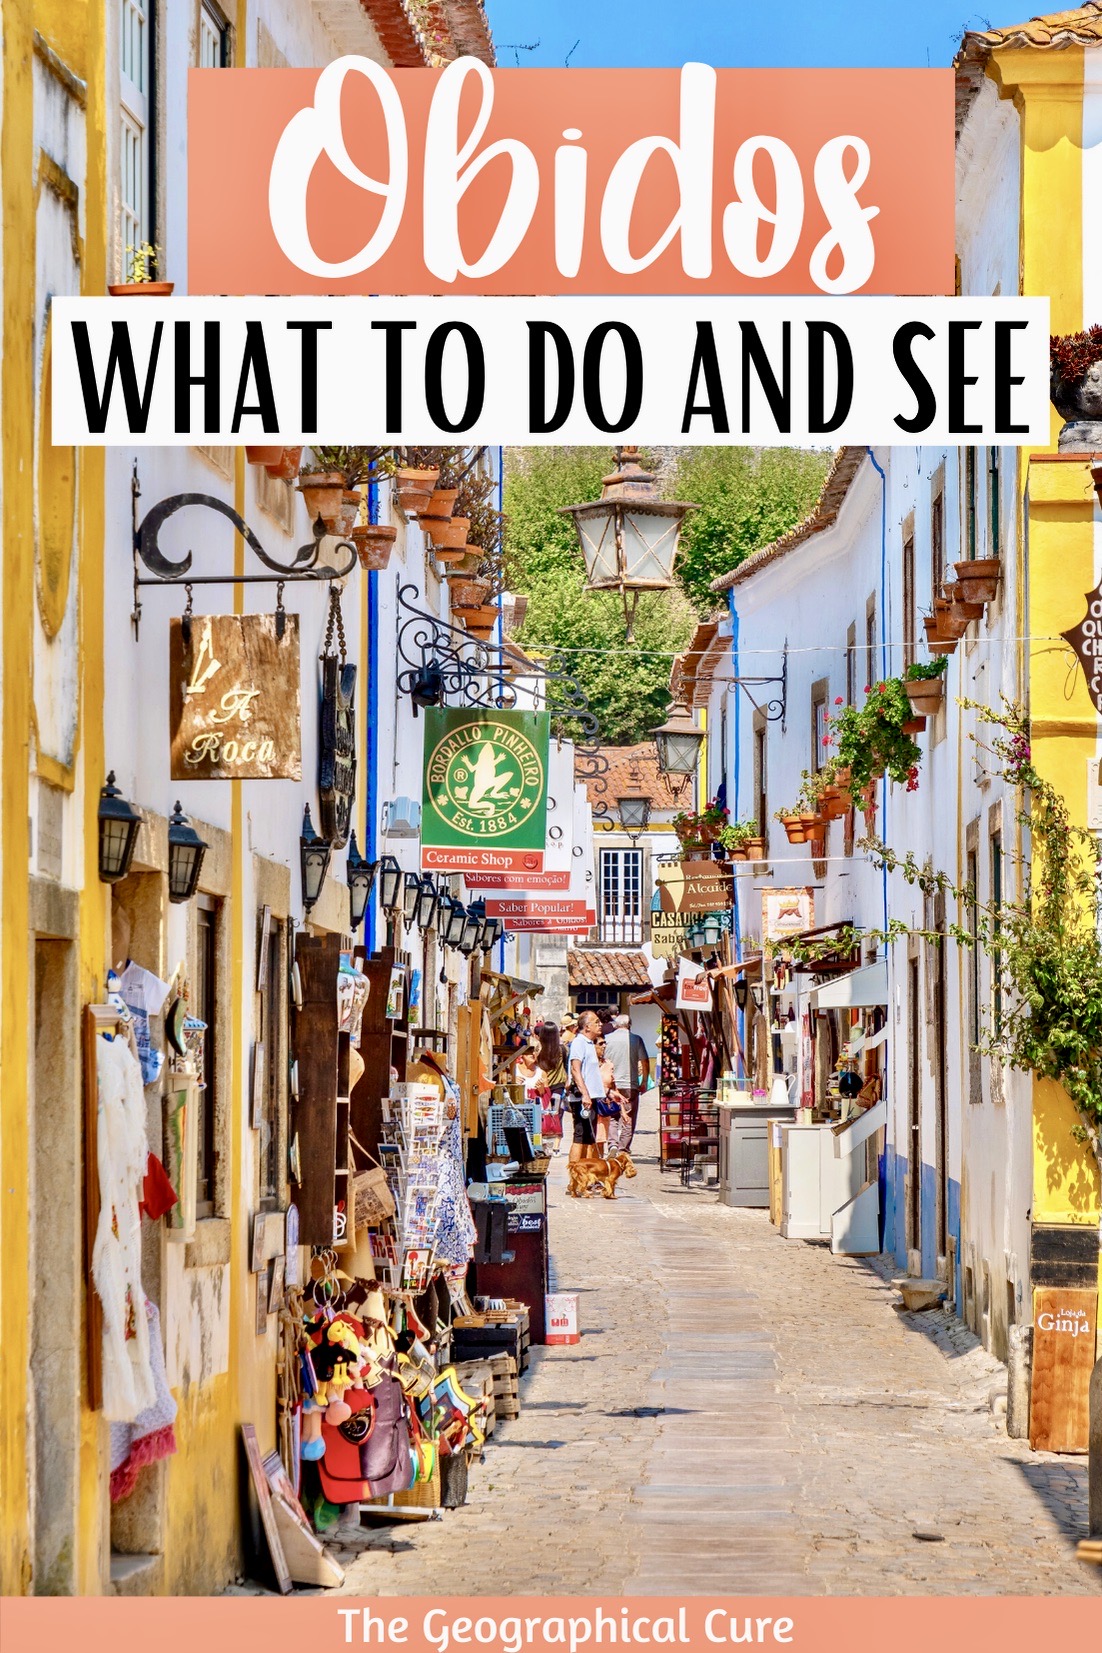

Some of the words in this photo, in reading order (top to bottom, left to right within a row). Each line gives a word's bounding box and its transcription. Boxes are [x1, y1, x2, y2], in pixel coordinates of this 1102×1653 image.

[208, 690, 261, 724] A
[184, 731, 276, 764] Roca
[430, 725, 482, 784] BORDALLO
[492, 726, 540, 787] PINHEIRO
[451, 811, 475, 832] Est.
[479, 811, 518, 833] 1884
[425, 851, 479, 867] Ceramic
[480, 853, 514, 869] Shop
[465, 872, 502, 884] Sabores
[503, 875, 524, 884] com
[526, 873, 567, 886] emoção!
[687, 881, 733, 895] Alcaide
[498, 902, 528, 913] Saber
[530, 902, 574, 915] Popular!
[652, 911, 683, 927] CASA
[1037, 1313, 1091, 1337] Ginja
